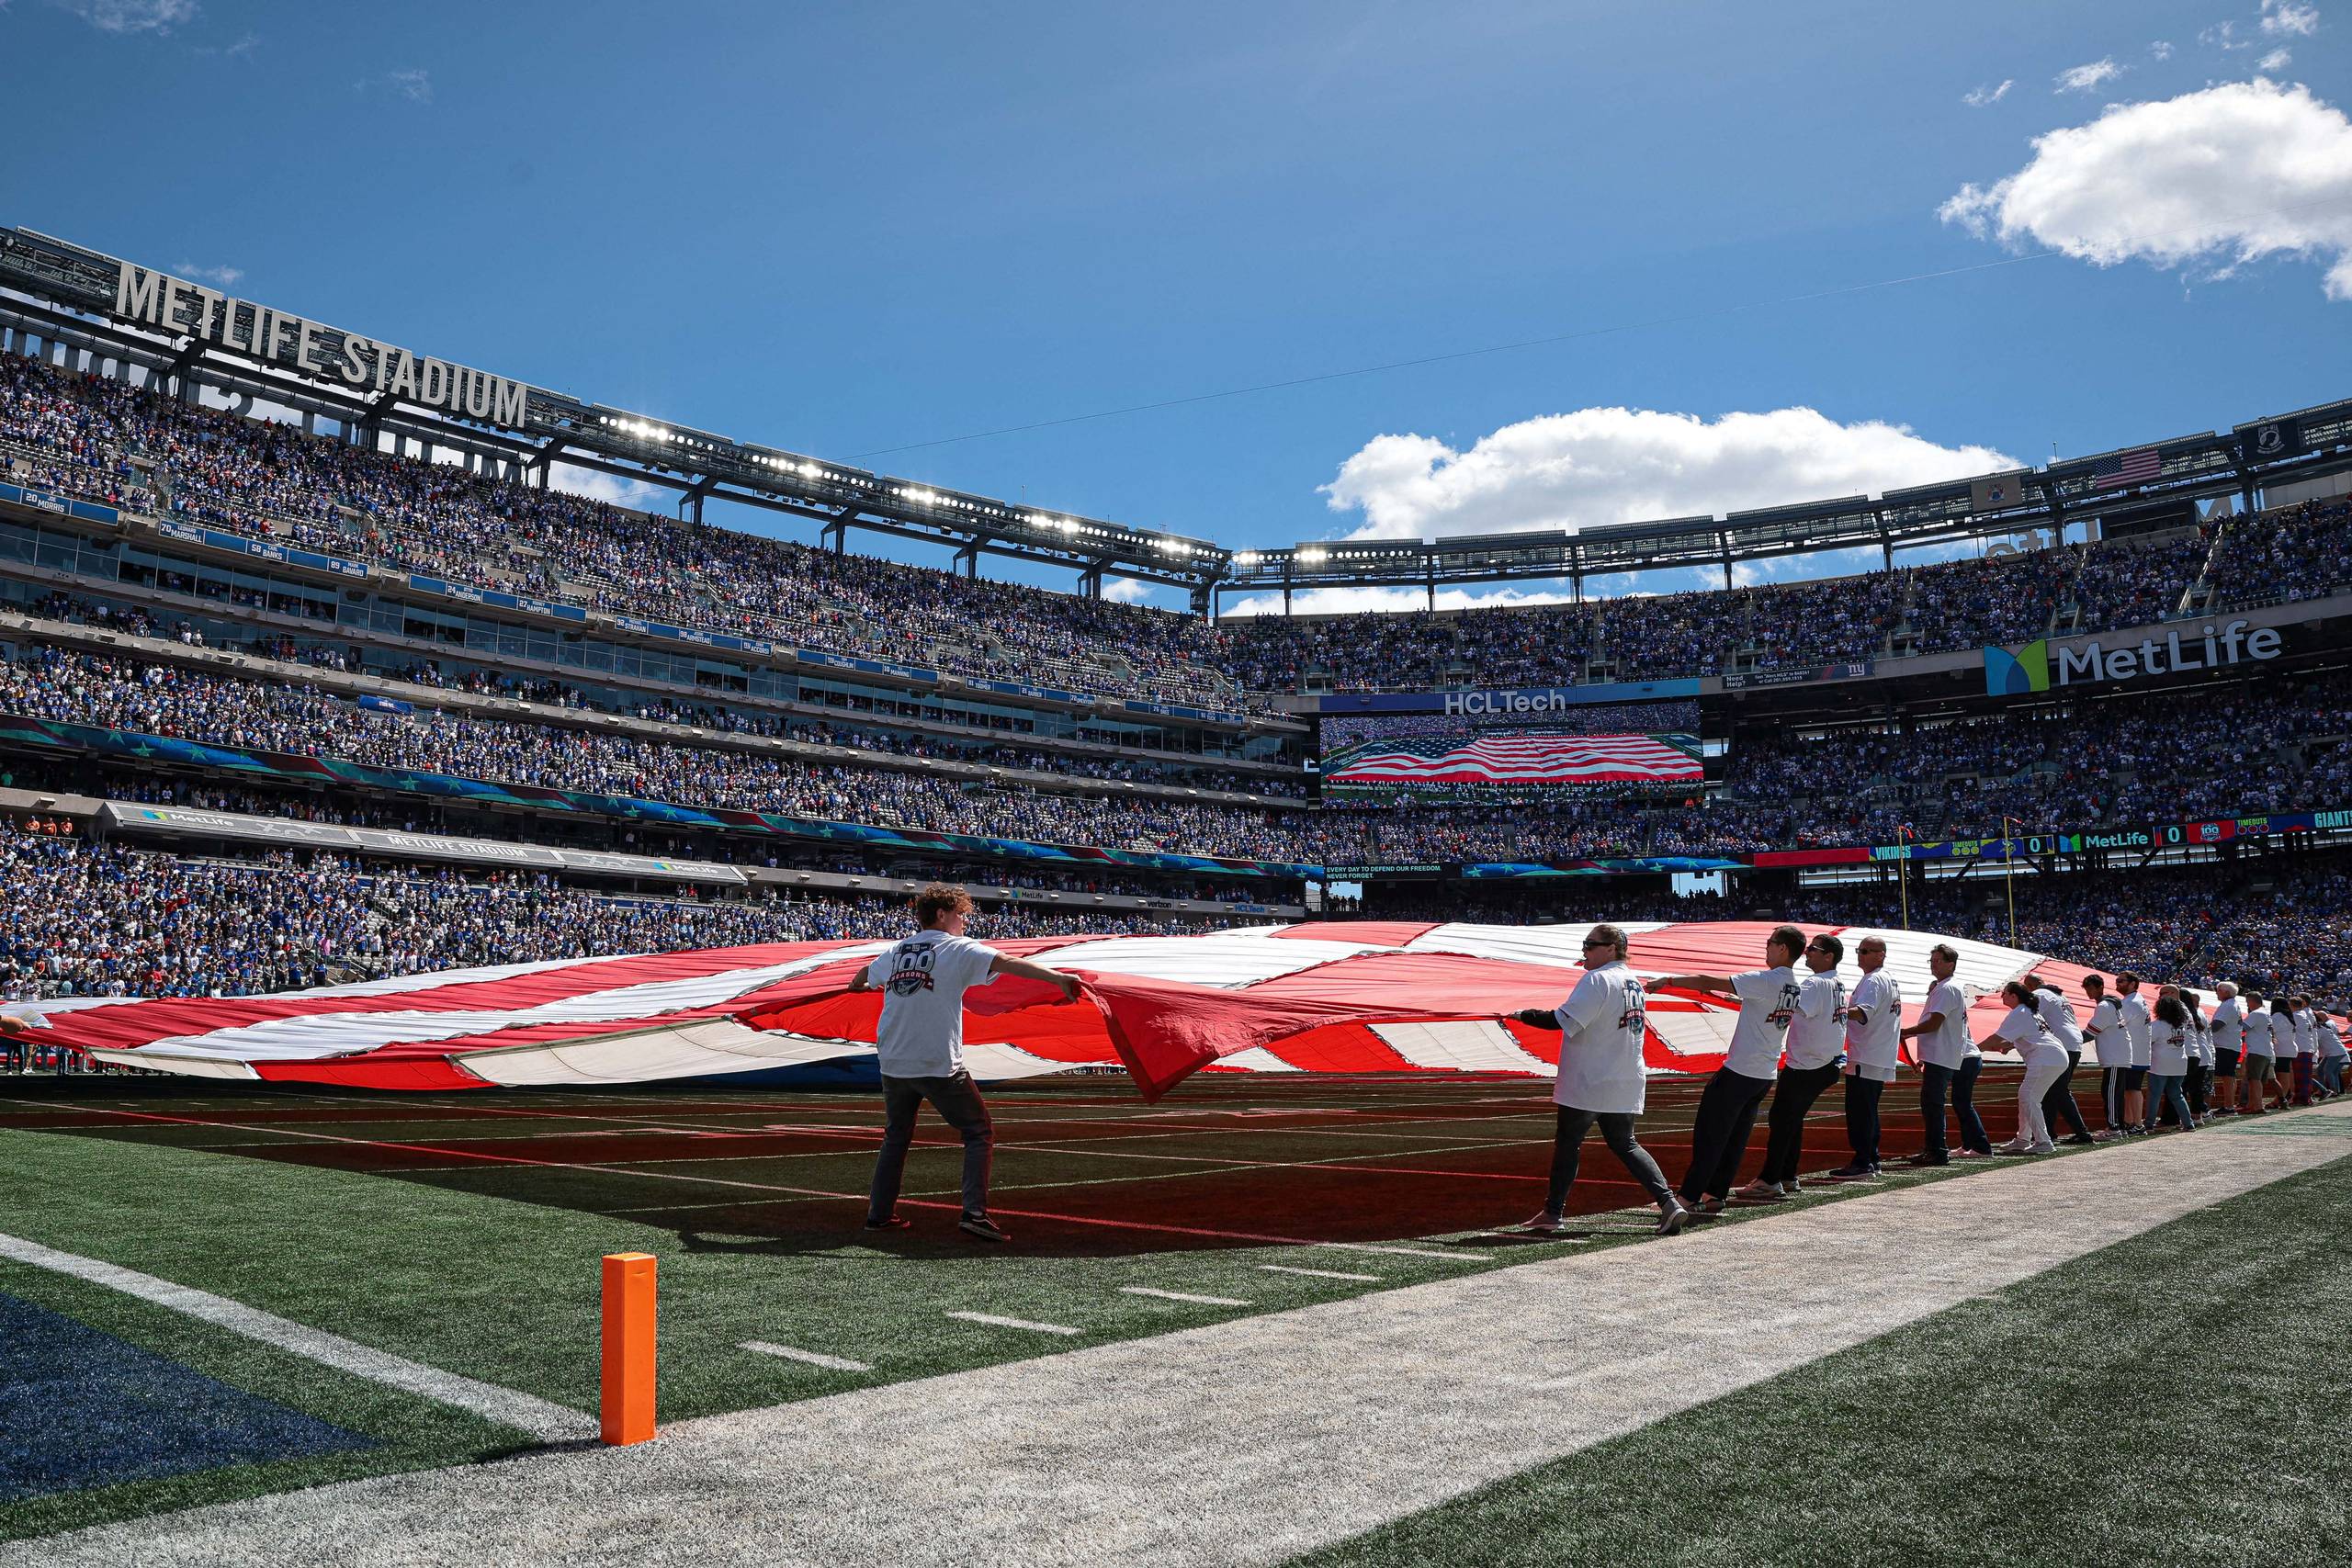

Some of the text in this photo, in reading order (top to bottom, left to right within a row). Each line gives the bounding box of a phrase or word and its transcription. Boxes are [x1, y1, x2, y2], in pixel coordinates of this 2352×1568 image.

[116, 261, 324, 372] METLIFE
[342, 334, 527, 428] STADIUM
[26, 492, 65, 513] 20 MORRIS
[161, 523, 203, 543] 70 MARSHALL
[251, 543, 283, 560] 58 BANKS
[447, 585, 482, 602] 24 ANDERSON
[519, 600, 551, 615] 27 HAMPTON
[625, 622, 647, 633] STRAHAN
[2059, 620, 2282, 685] MetLife
[884, 664, 891, 672] 10
[890, 669, 910, 677] MANNING
[1727, 680, 1746, 688] Help?
[1444, 690, 1566, 715] HCLTech
[170, 814, 234, 828] MetLife
[2237, 818, 2267, 826] TIMEOUTS
[2086, 832, 2149, 849] MetLife
[2168, 828, 2180, 842] 0
[387, 836, 528, 858] METLIFE STADIUM
[2030, 837, 2041, 852] 0
[673, 865, 718, 874] MetLife
[1022, 891, 1044, 899] MetLife
[1148, 900, 1265, 913] verizon HCLTech
[893, 950, 935, 973] 100
[891, 971, 926, 982] SEASONS
